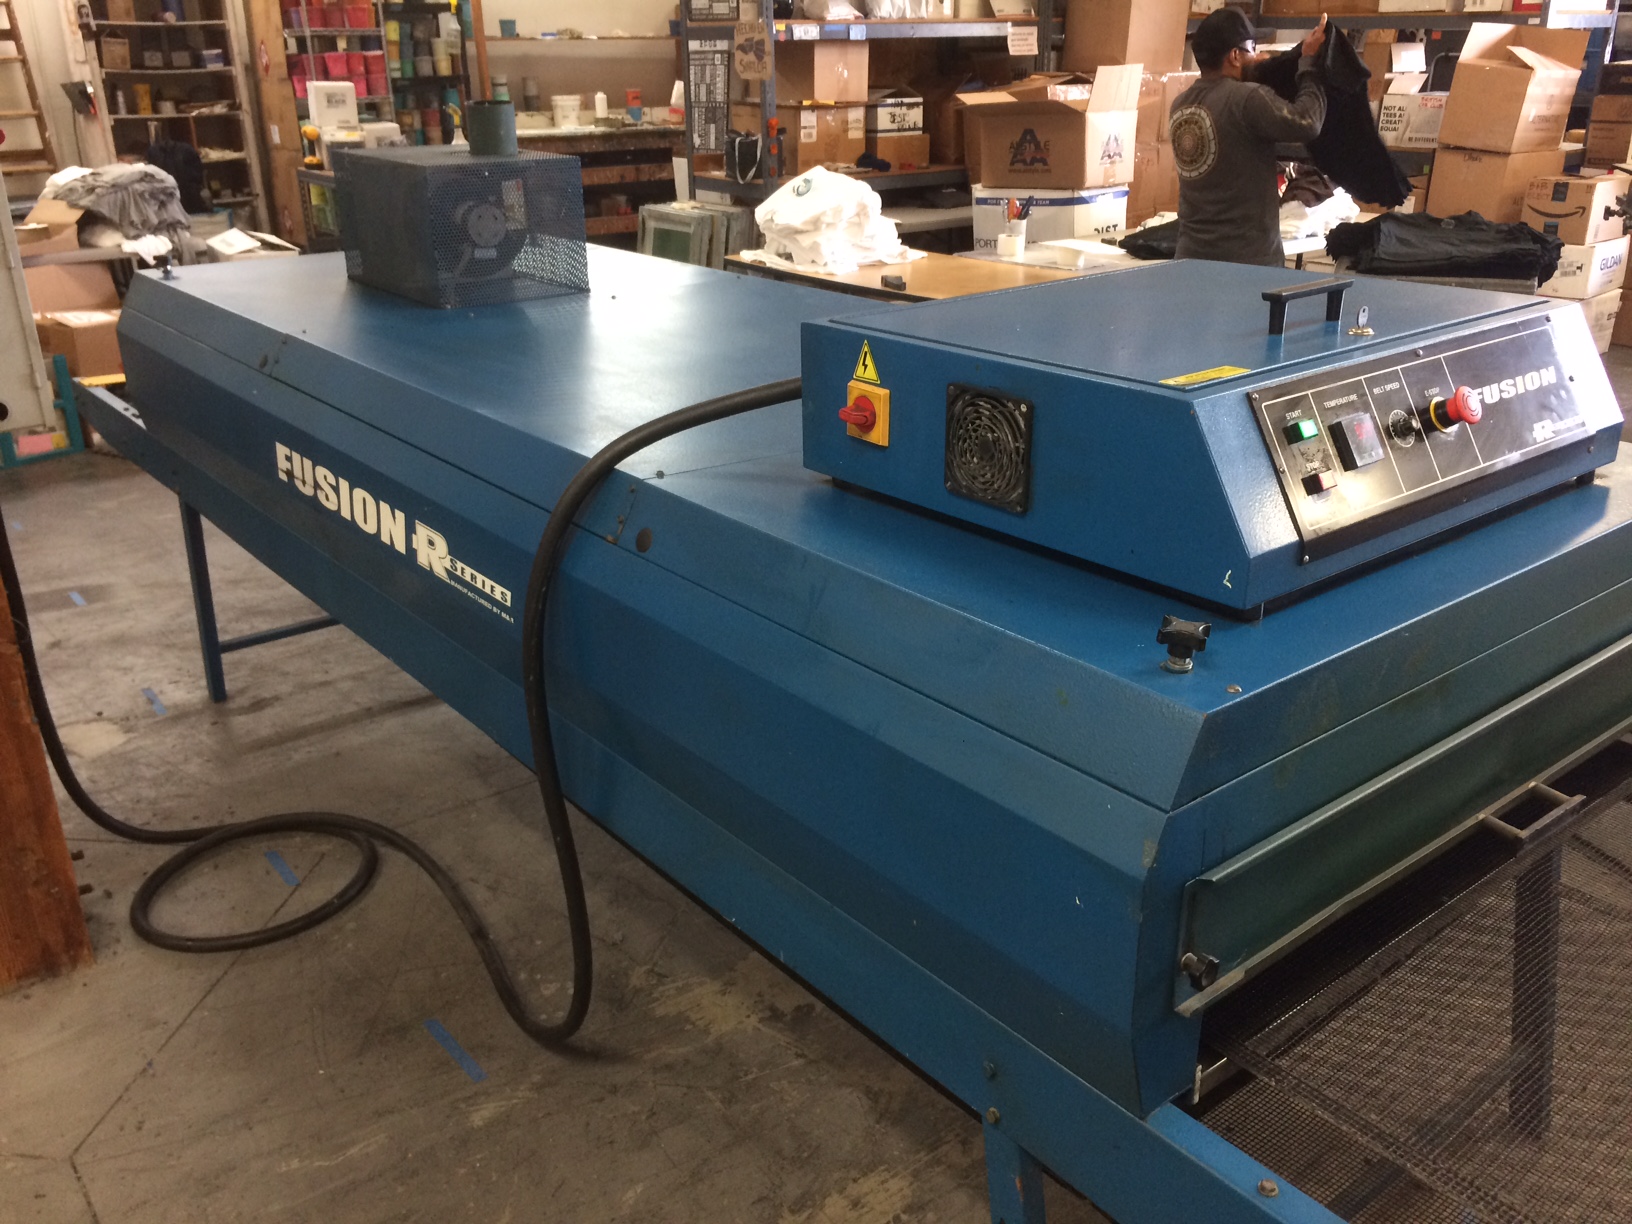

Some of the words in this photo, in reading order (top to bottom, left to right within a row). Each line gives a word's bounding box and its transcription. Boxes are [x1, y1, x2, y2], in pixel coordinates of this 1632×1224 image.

[975, 237, 998, 249] PORT
[1600, 253, 1622, 271] GILDAN
[1372, 385, 1385, 394] BELT
[1385, 382, 1400, 392] SPEED
[1323, 393, 1359, 409] TEMPERATURE
[1285, 410, 1302, 420] START
[1306, 460, 1320, 472] STOP
[275, 441, 406, 555] FUSION
[449, 557, 508, 603] SERIES
[450, 579, 493, 610] MANUFACTURED
[492, 606, 501, 615] BY
